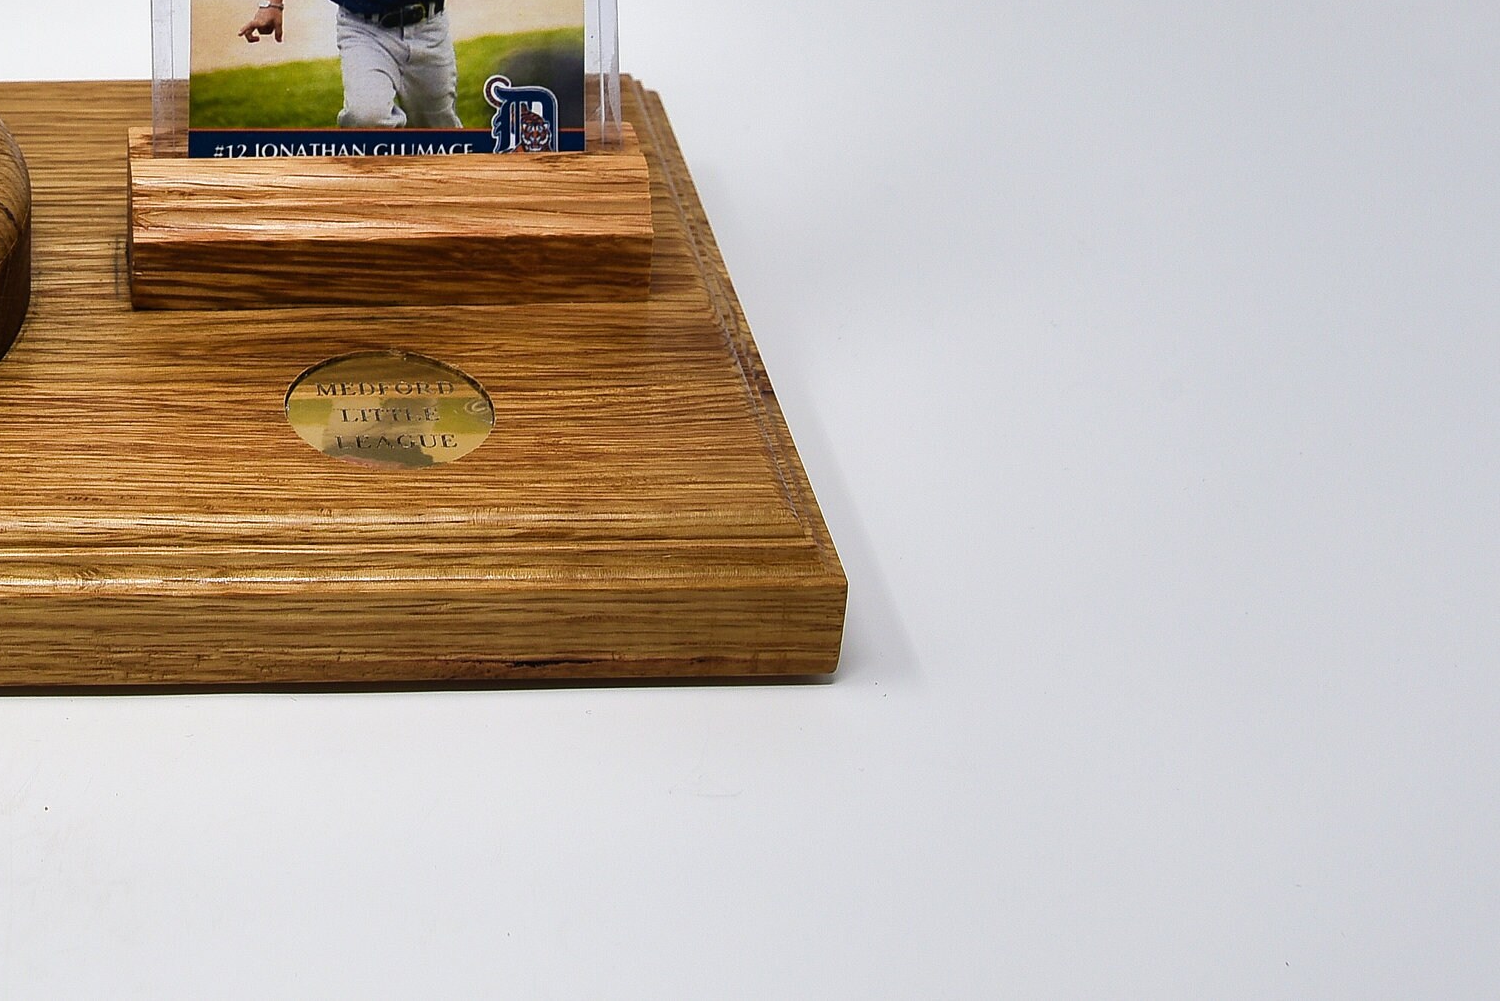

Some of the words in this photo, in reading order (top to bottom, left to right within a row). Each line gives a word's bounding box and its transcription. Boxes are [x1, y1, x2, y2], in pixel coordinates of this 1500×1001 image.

[213, 144, 248, 158] #12
[254, 143, 366, 157] JONATHAN
[315, 381, 455, 397] MEDFORD
[341, 407, 440, 423] LITTLE
[334, 434, 458, 449] LEAGUE
